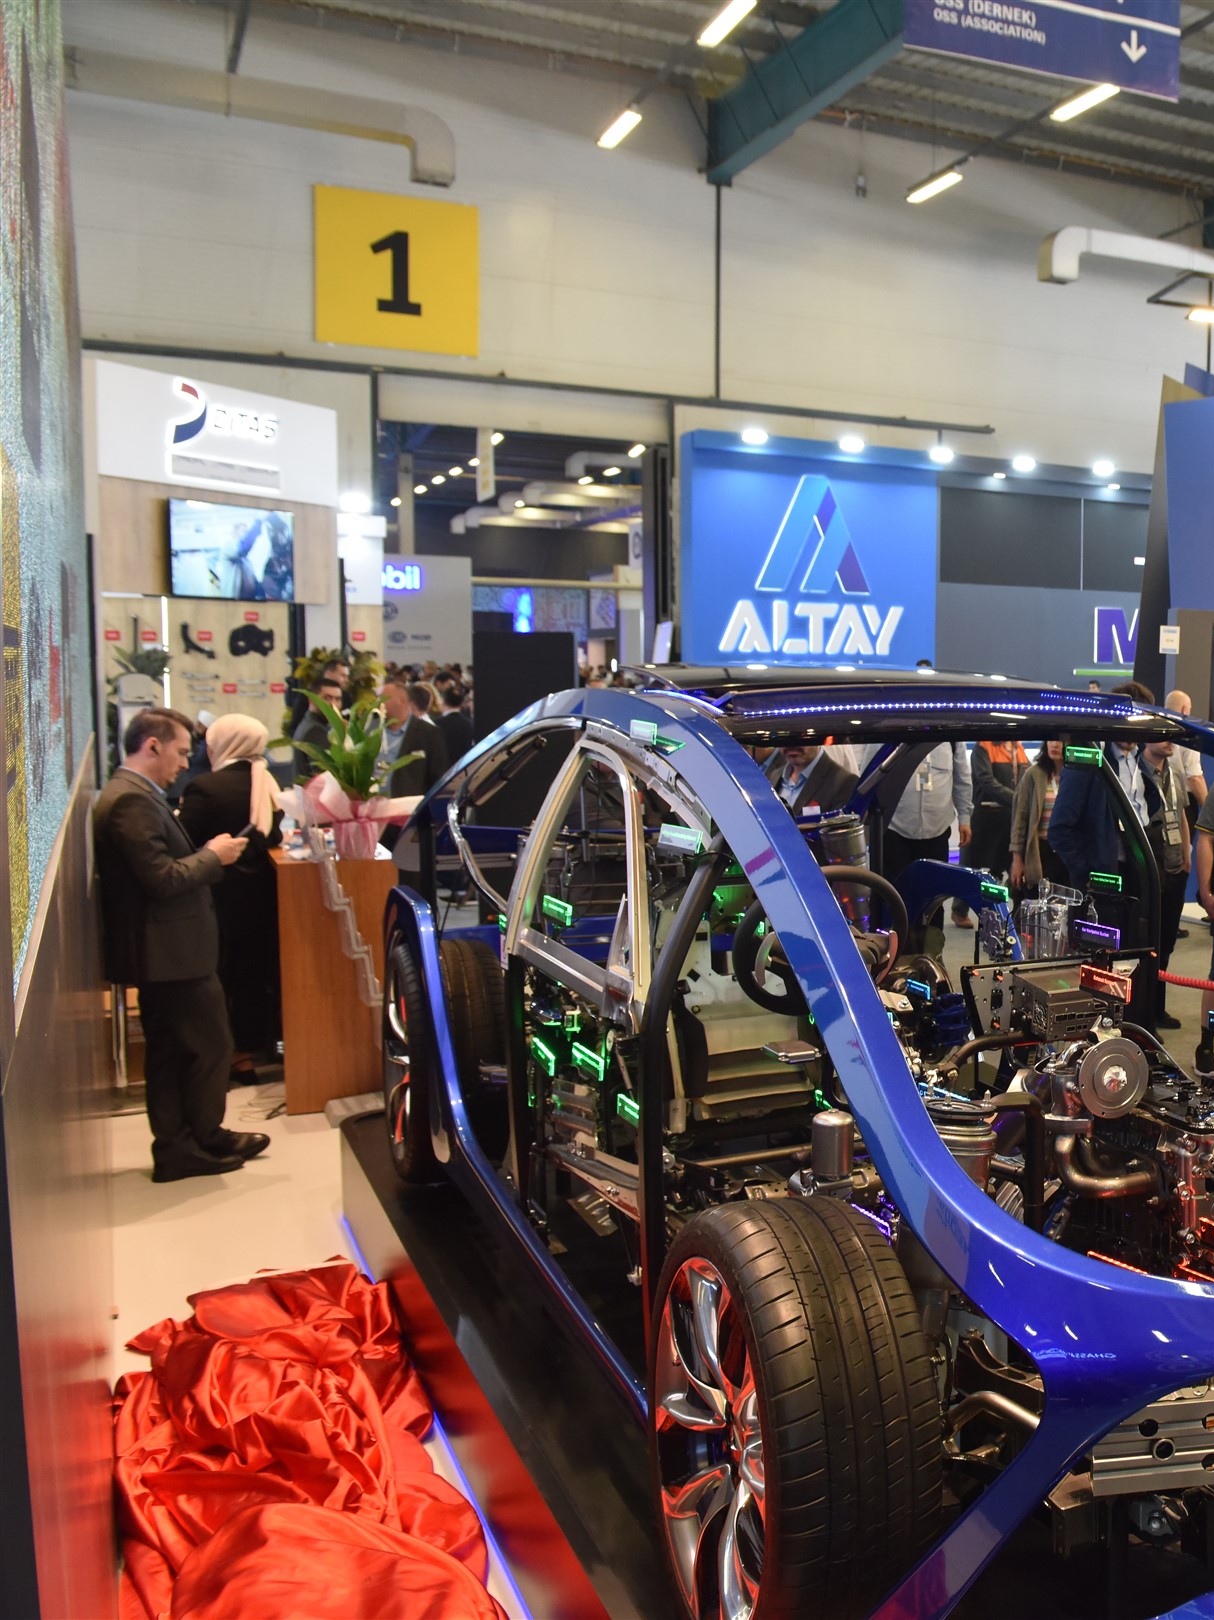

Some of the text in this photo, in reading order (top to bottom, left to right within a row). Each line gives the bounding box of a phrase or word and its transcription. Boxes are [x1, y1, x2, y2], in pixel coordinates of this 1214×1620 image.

[933, 8, 1046, 46] OSS (ASSOCIATION)
[968, 0, 1037, 28] (DERNEK)
[371, 230, 422, 316] 1
[383, 564, 421, 590] bil
[718, 599, 904, 656] ALTAY
